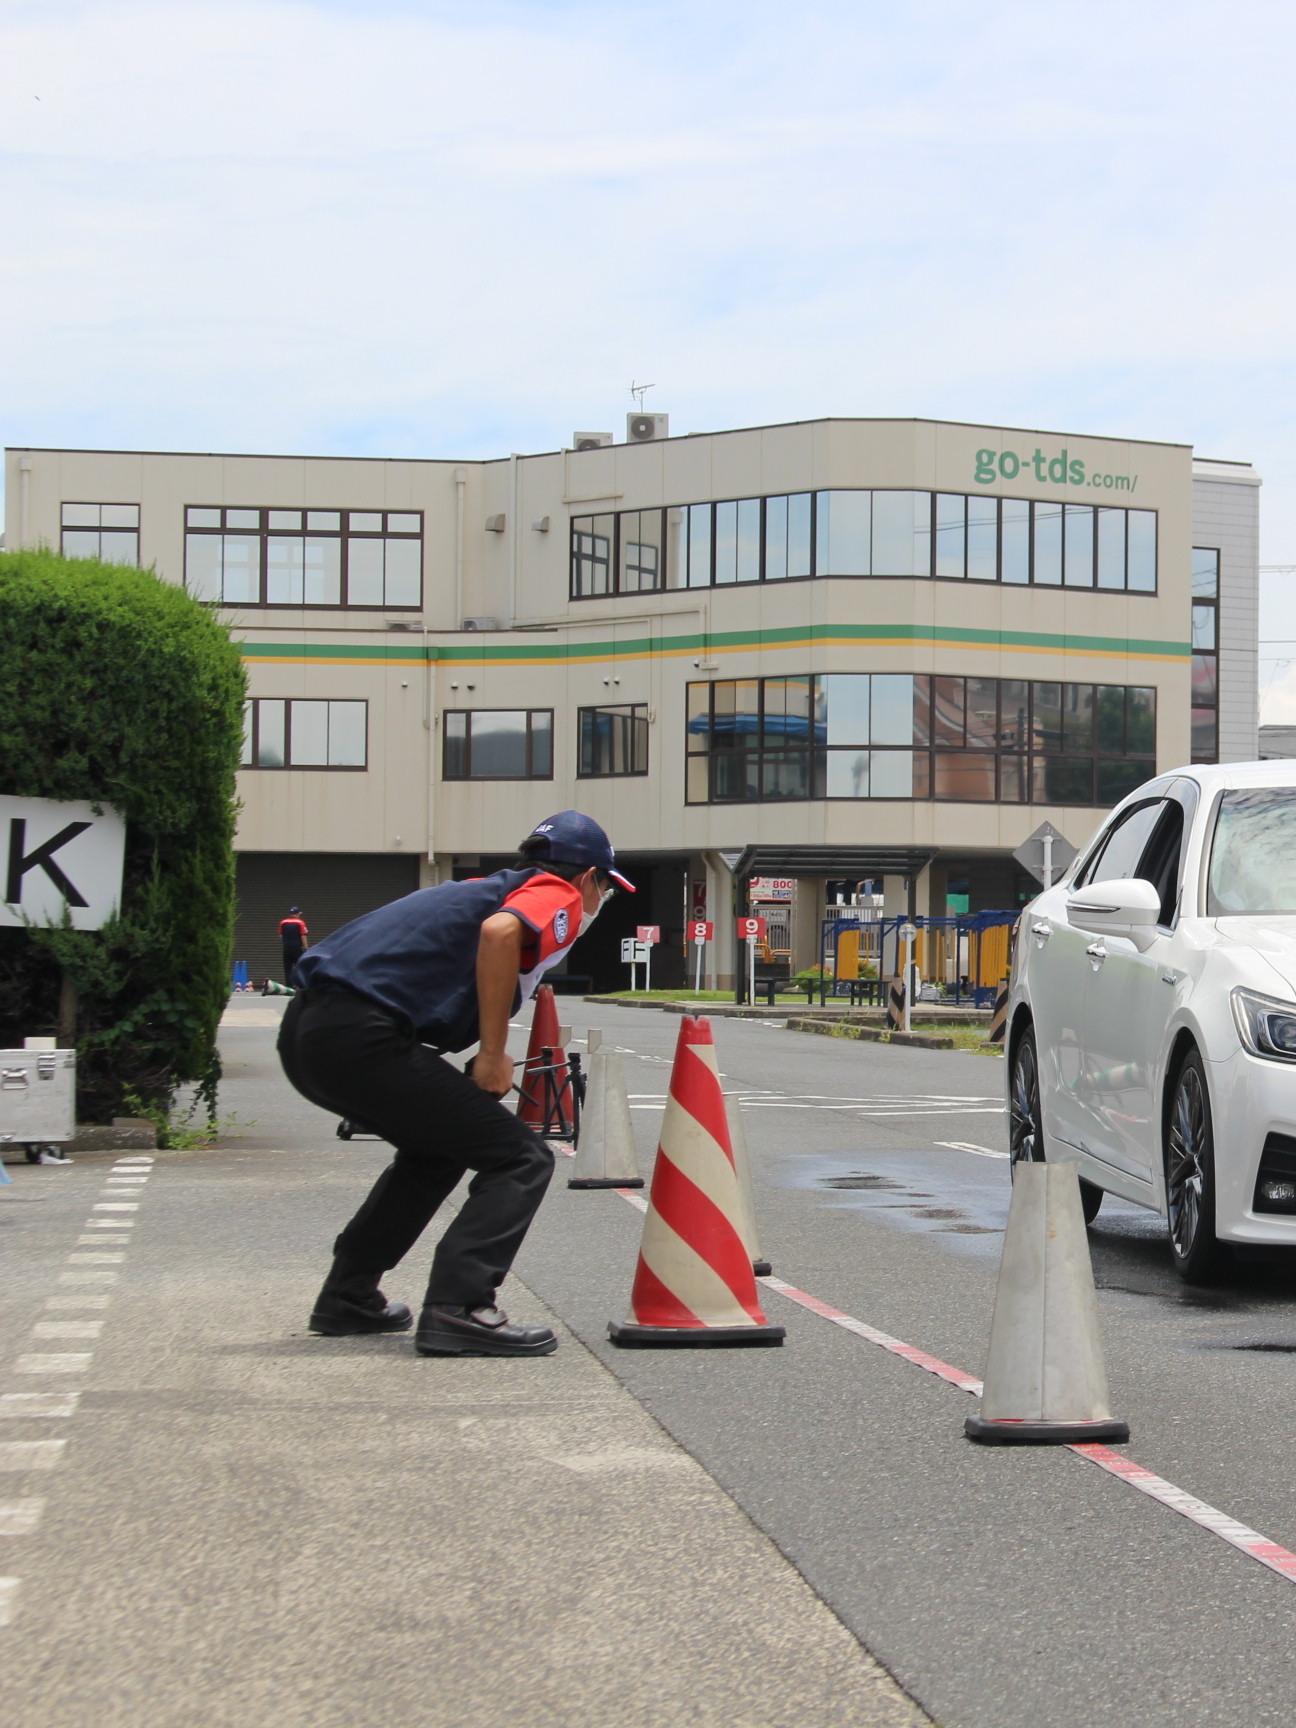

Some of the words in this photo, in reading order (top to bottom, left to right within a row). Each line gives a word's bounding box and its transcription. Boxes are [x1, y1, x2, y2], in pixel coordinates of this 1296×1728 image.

[6, 818, 93, 908] K
[642, 927, 655, 939] 7
[694, 922, 707, 936] 8
[745, 919, 759, 934] 9
